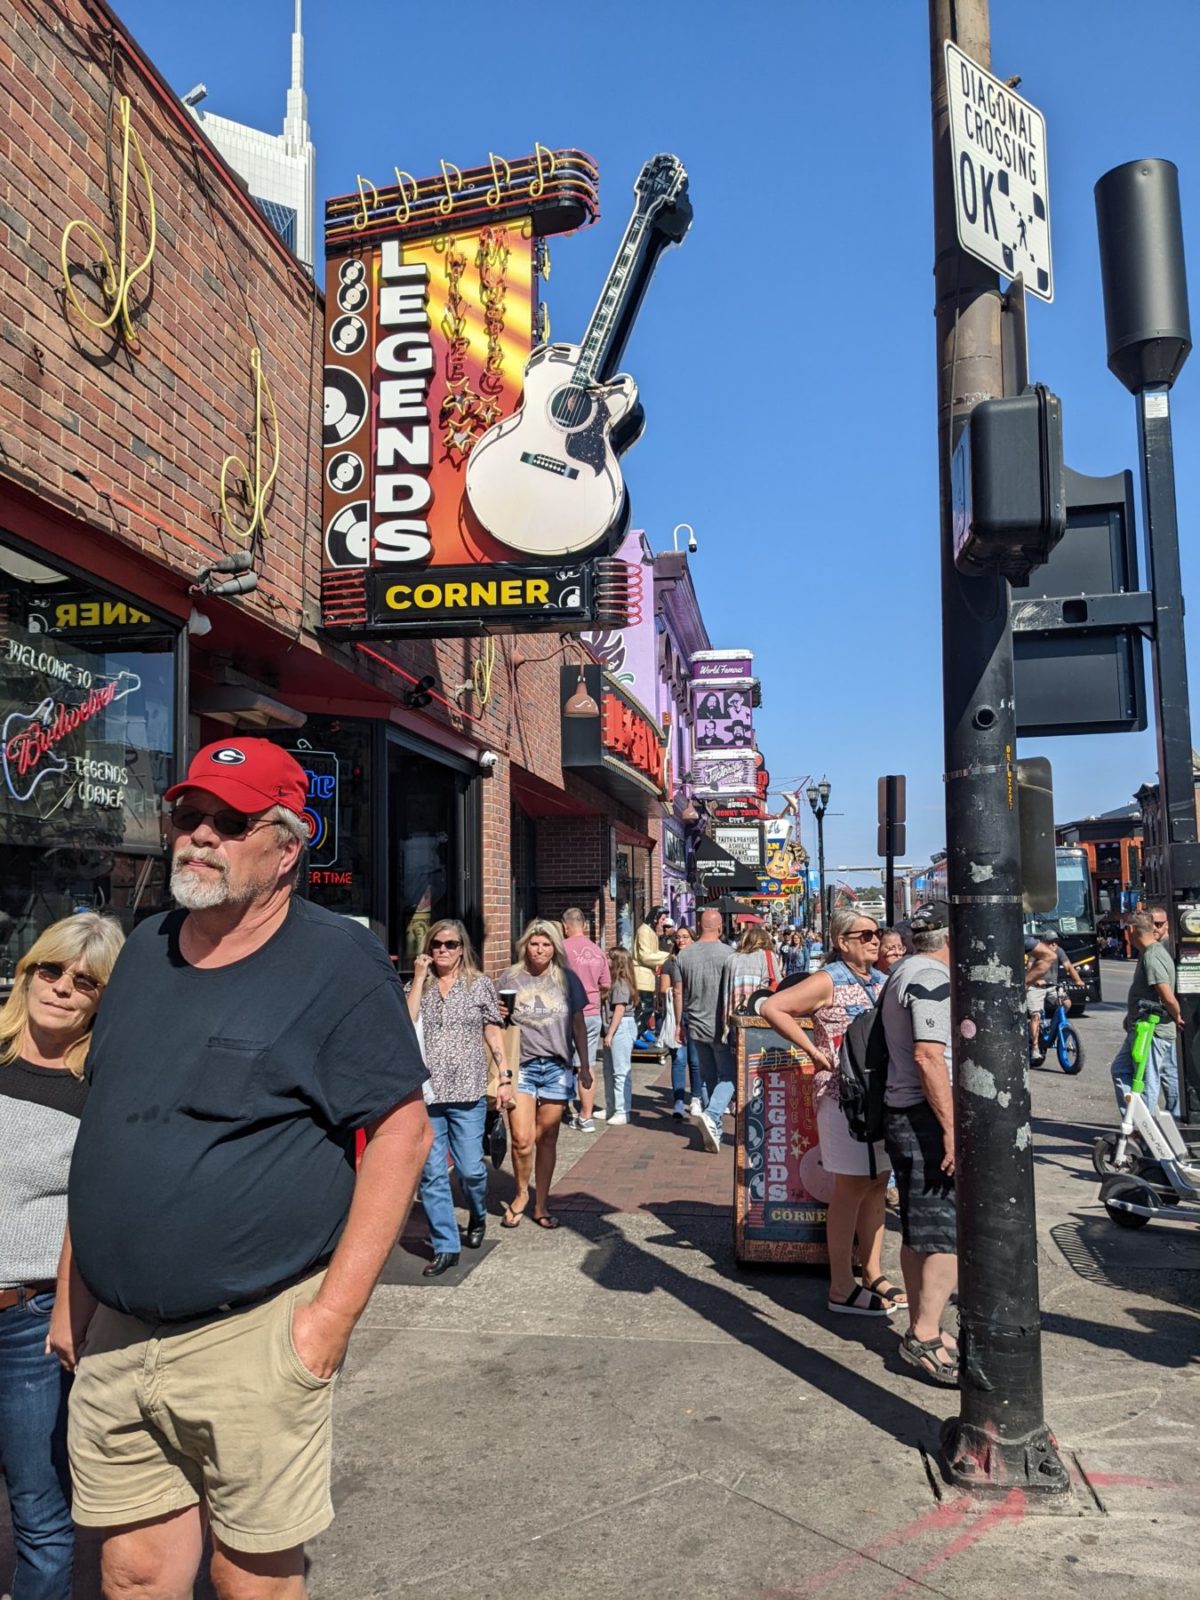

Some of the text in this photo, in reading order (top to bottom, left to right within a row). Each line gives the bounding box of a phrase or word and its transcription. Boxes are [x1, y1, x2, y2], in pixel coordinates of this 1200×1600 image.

[960, 60, 1037, 149] DIAGONAL
[964, 102, 1037, 187] CROSSING
[959, 150, 1000, 242] OK
[373, 240, 434, 563] LEGENDS
[385, 578, 549, 609] CORNER
[5, 639, 92, 689] WELCOME TO
[700, 664, 744, 676] World Famous
[6, 681, 118, 776] Budweiser
[75, 756, 129, 785] LEGENDS
[78, 781, 125, 808] CORNER
[322, 871, 353, 884] TIME
[767, 1072, 789, 1201] LEGENDS
[771, 1209, 827, 1222] CORNE
